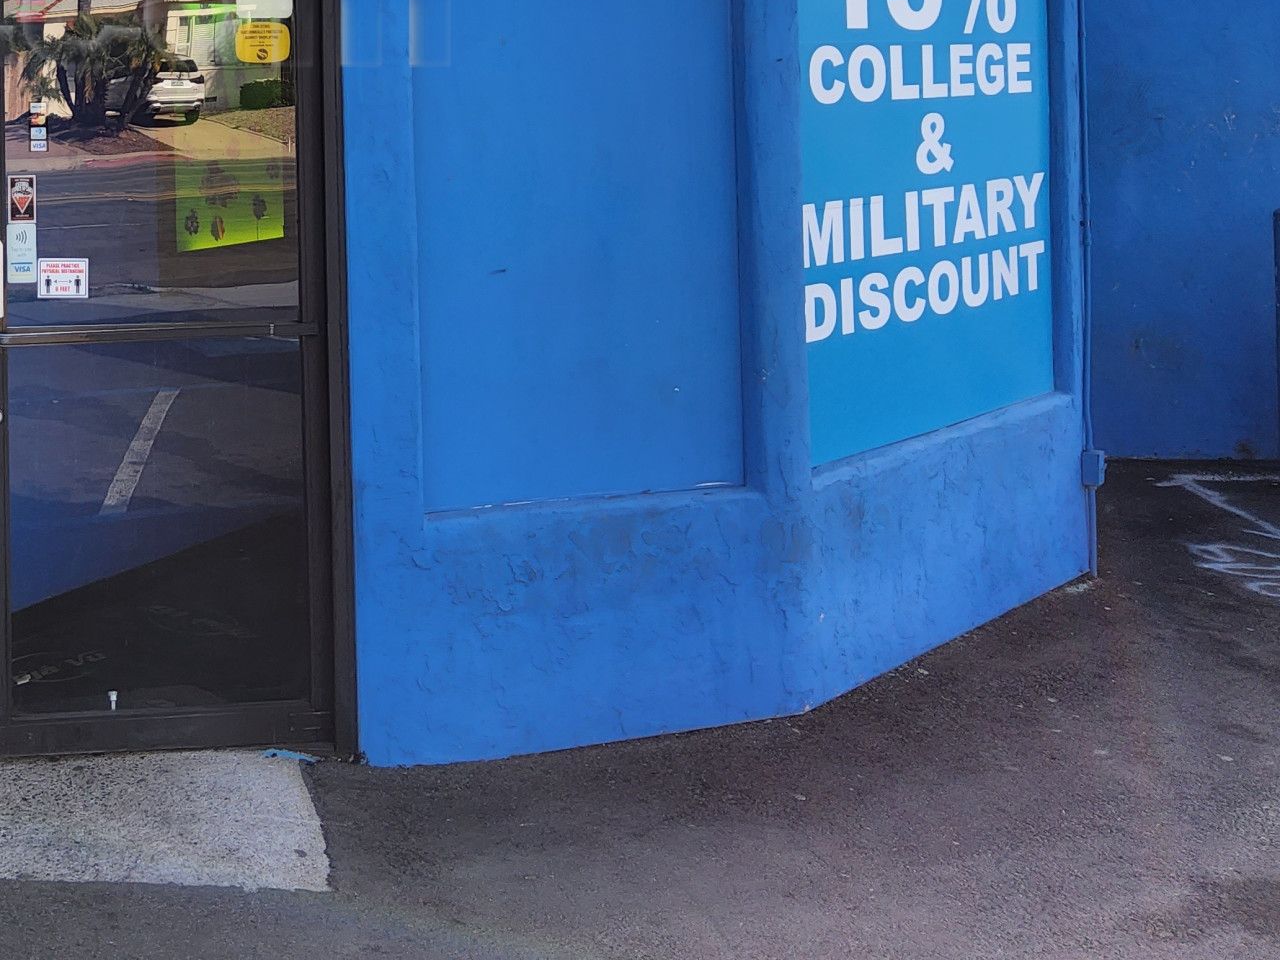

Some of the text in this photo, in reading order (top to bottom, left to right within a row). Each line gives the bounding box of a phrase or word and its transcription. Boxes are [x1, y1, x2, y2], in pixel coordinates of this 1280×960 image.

[809, 42, 1032, 105] COLLEGE
[916, 112, 954, 175] &
[802, 172, 1045, 269] MILITARY
[14, 265, 31, 273] VISA
[804, 240, 1045, 344] DISCOUNT
